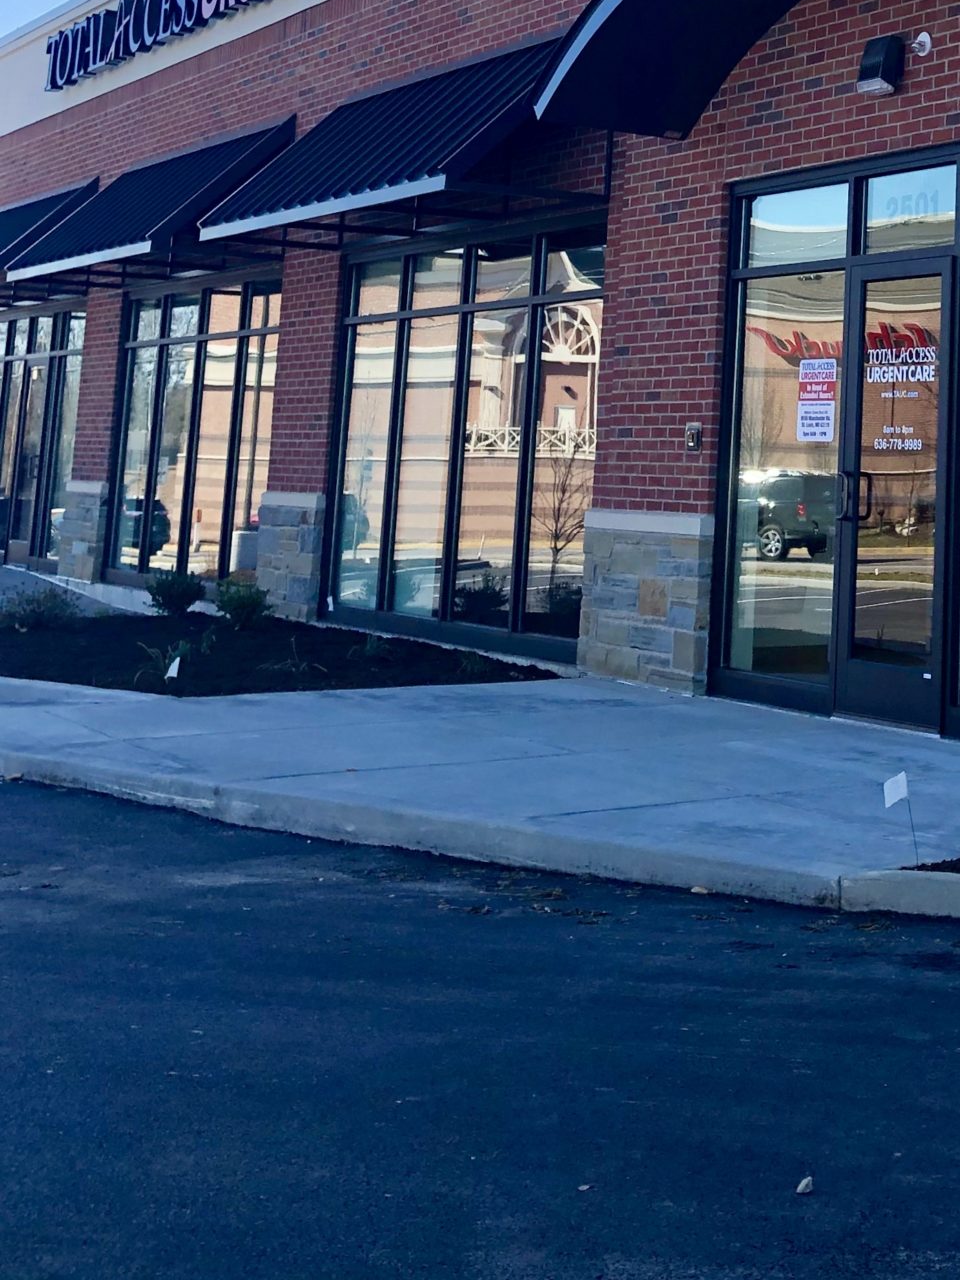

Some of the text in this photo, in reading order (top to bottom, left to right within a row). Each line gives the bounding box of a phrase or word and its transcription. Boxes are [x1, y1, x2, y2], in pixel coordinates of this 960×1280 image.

[45, 8, 115, 91] TOTAL
[867, 346, 936, 364] TOTAL ACCESS
[801, 363, 817, 371] TOTAL
[895, 425, 901, 433] to
[873, 438, 922, 451] 636-778-9989
